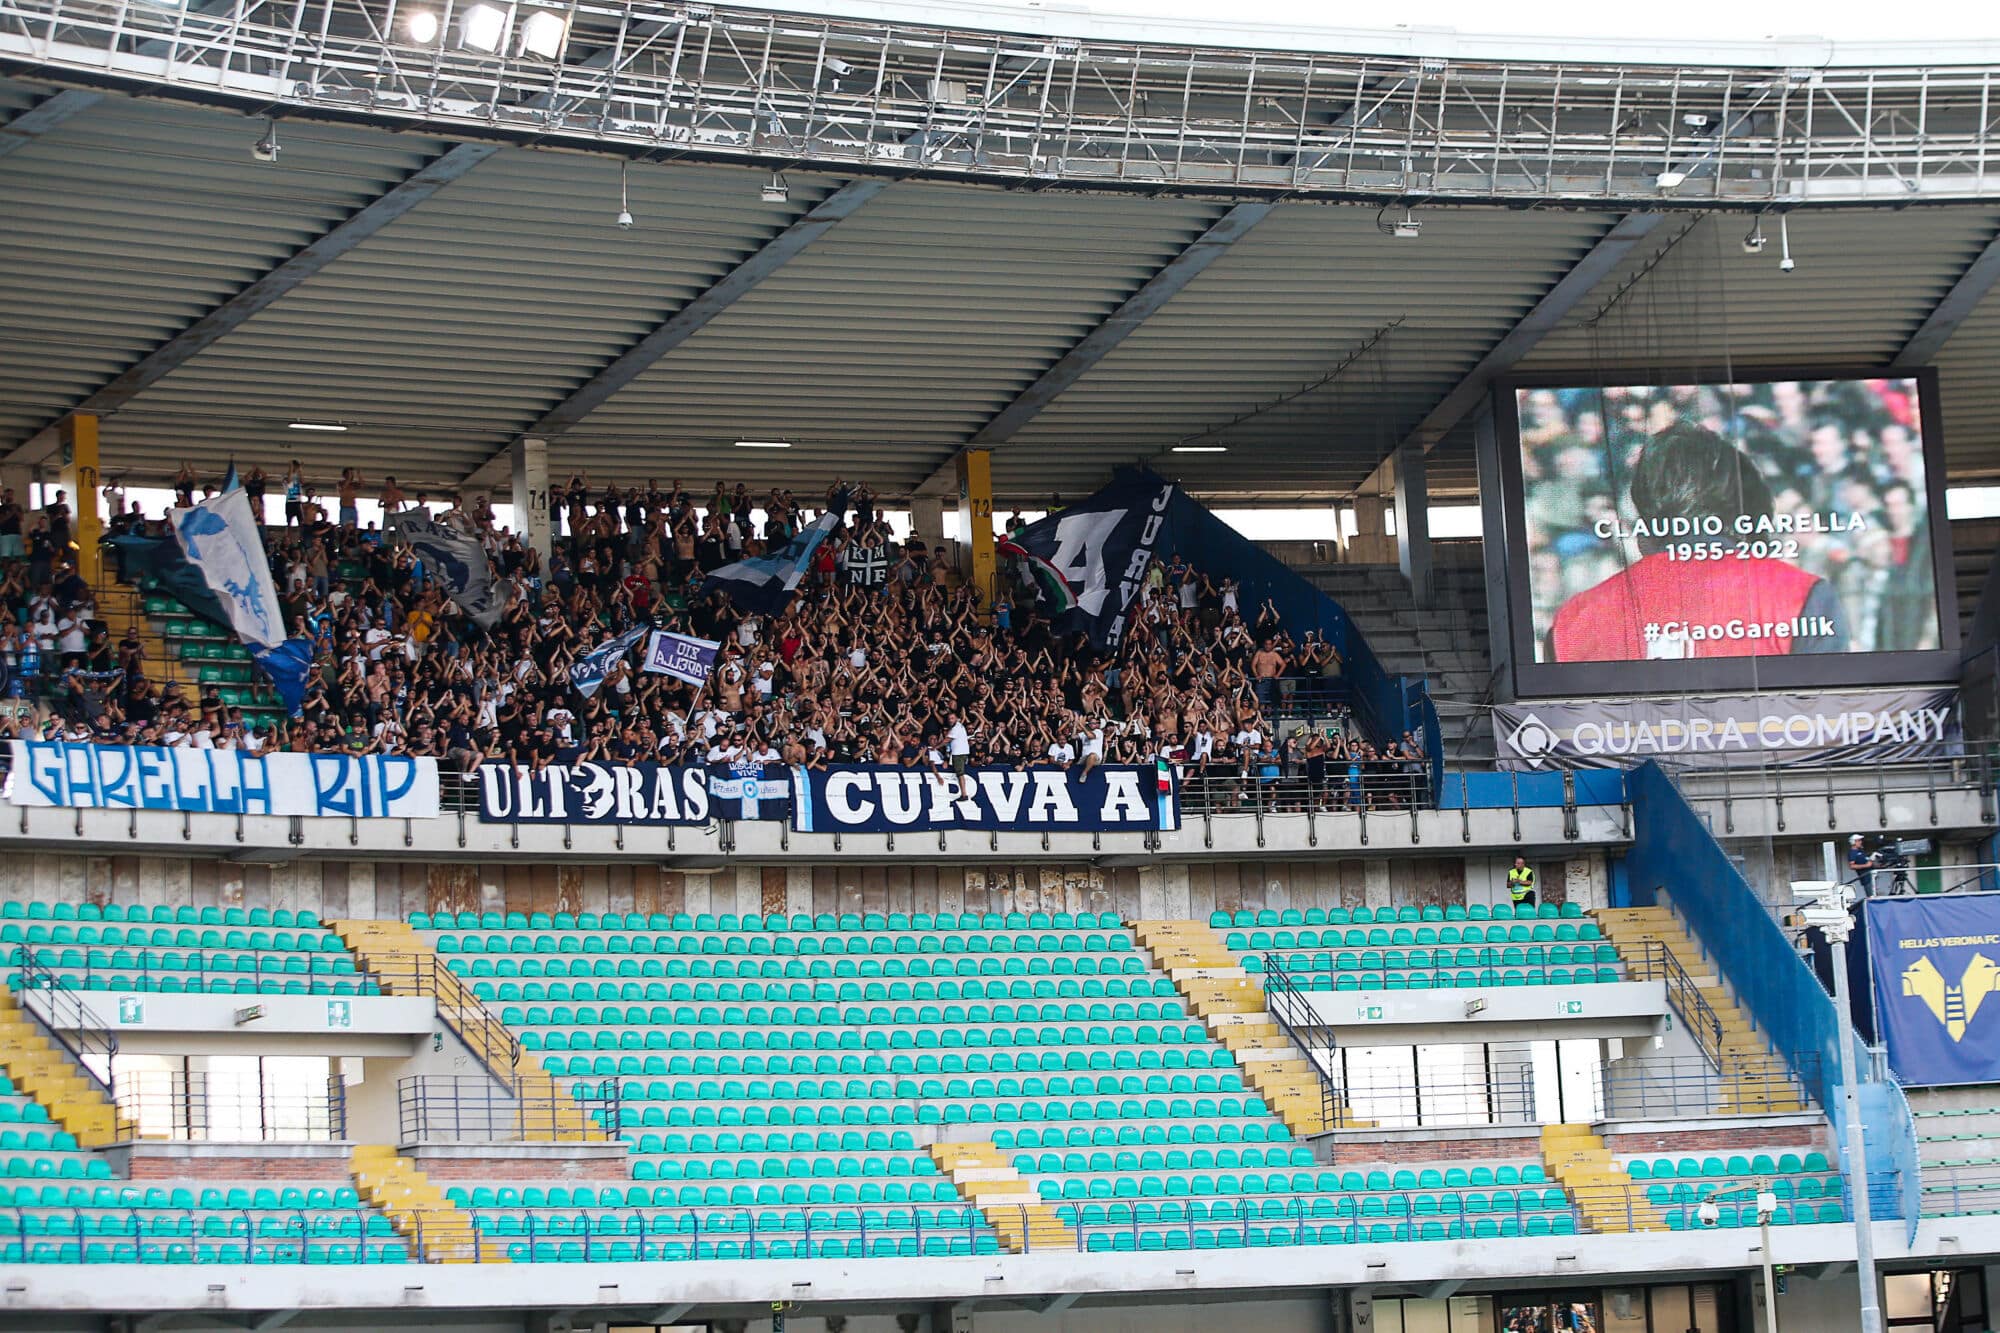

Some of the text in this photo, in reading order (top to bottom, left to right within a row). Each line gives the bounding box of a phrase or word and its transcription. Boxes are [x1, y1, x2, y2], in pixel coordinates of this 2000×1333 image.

[530, 490, 546, 510] 71
[1594, 512, 1867, 538] CLAUDIO GARELLA
[1665, 540, 1800, 561] 1955-2022
[1643, 616, 1835, 642] #CiaoGarellik
[1573, 707, 1951, 755] QUADRA COMPANY
[26, 740, 416, 817] GARELLA RIP
[825, 771, 1150, 824] CURVA A
[1899, 934, 2000, 949] HELLAS VERONA FC
